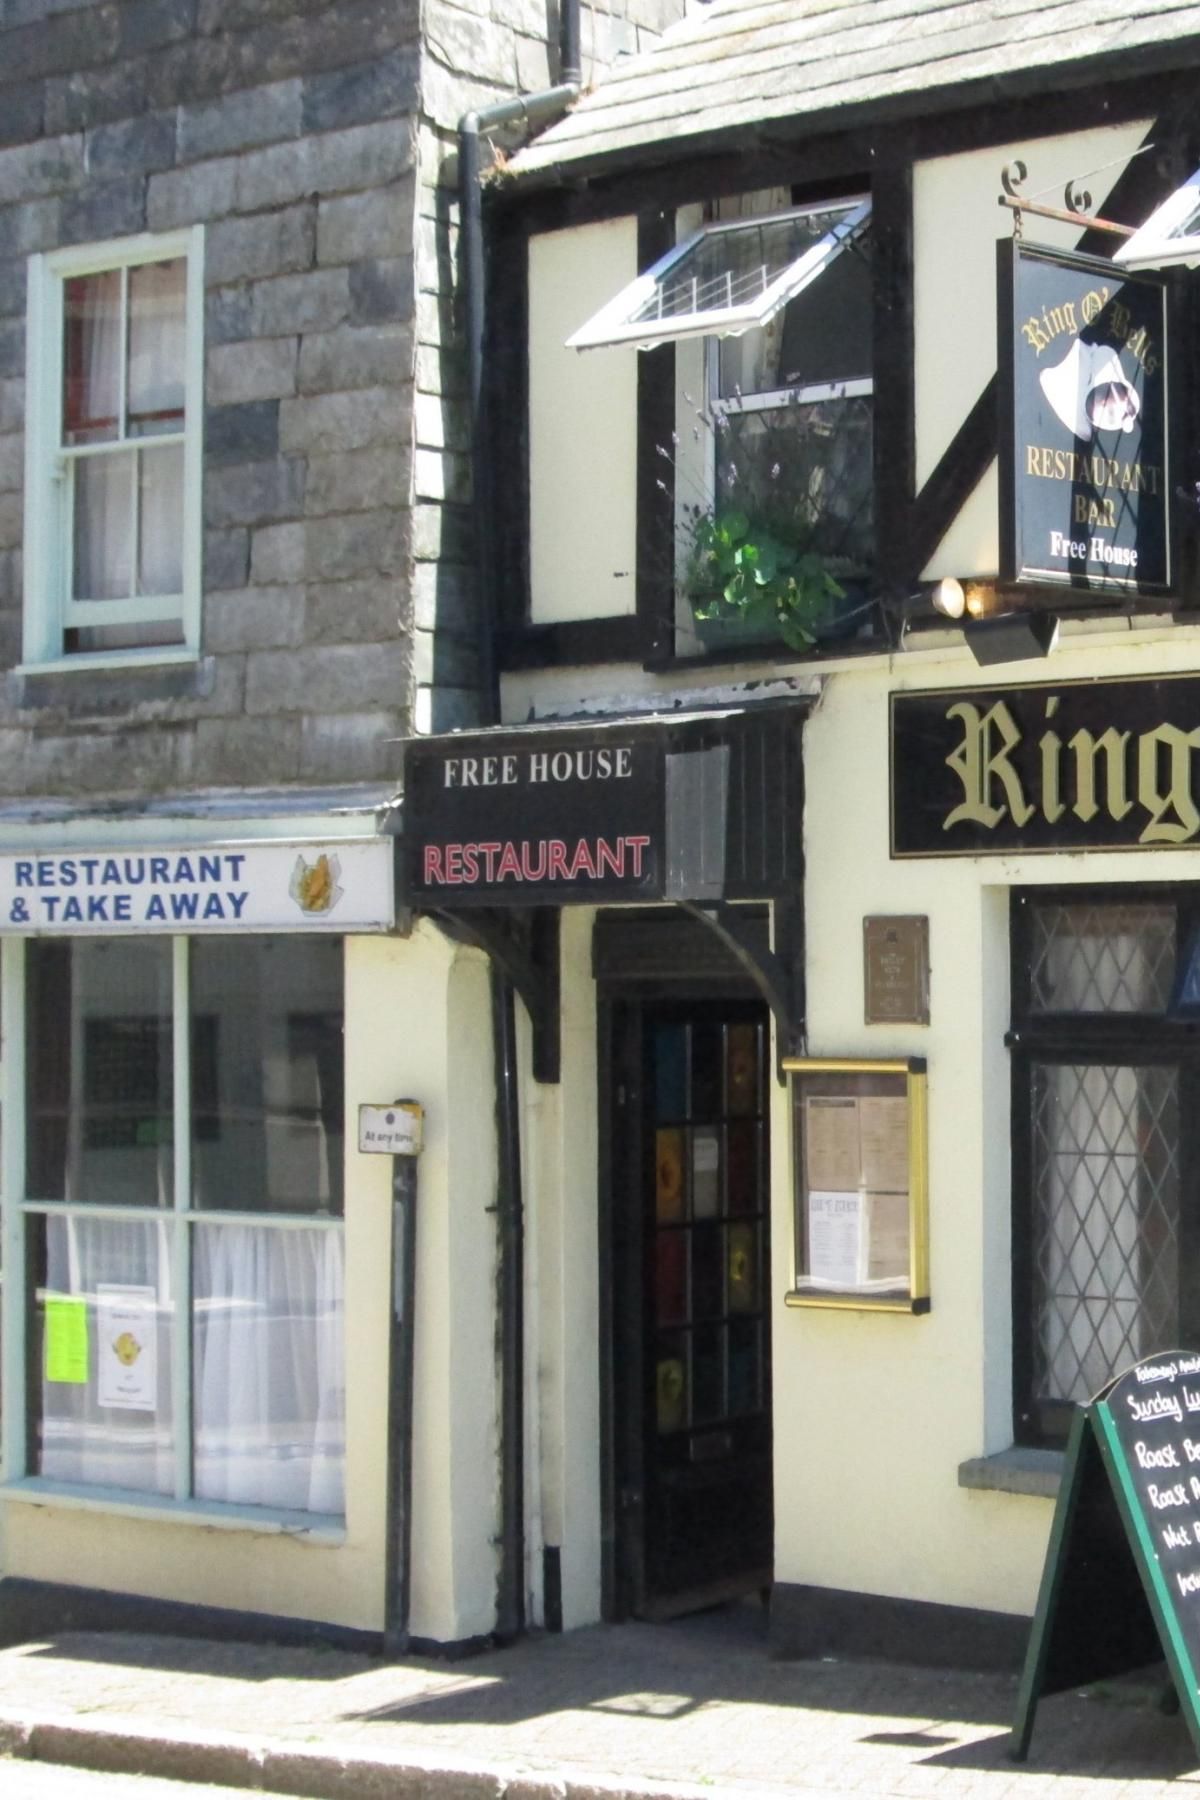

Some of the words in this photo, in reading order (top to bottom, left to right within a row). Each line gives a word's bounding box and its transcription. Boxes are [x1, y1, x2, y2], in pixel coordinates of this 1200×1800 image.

[1021, 300, 1077, 357] Ring
[1026, 445, 1161, 496] RESTAURANT
[1074, 494, 1116, 528] BAR
[1050, 530, 1087, 561] Free
[1089, 537, 1138, 567] House
[443, 756, 517, 788] FREE
[529, 748, 634, 783] HOUSE
[15, 855, 246, 888] RESTAURANT
[423, 836, 650, 885] RESTAURANT
[9, 896, 29, 922] &
[42, 896, 132, 923] TAKE
[146, 891, 250, 921] AWAY
[1127, 1391, 1184, 1423] Sunday
[1135, 1441, 1181, 1469] Roast
[1147, 1482, 1191, 1510] Roast
[1162, 1524, 1192, 1549] Nut
